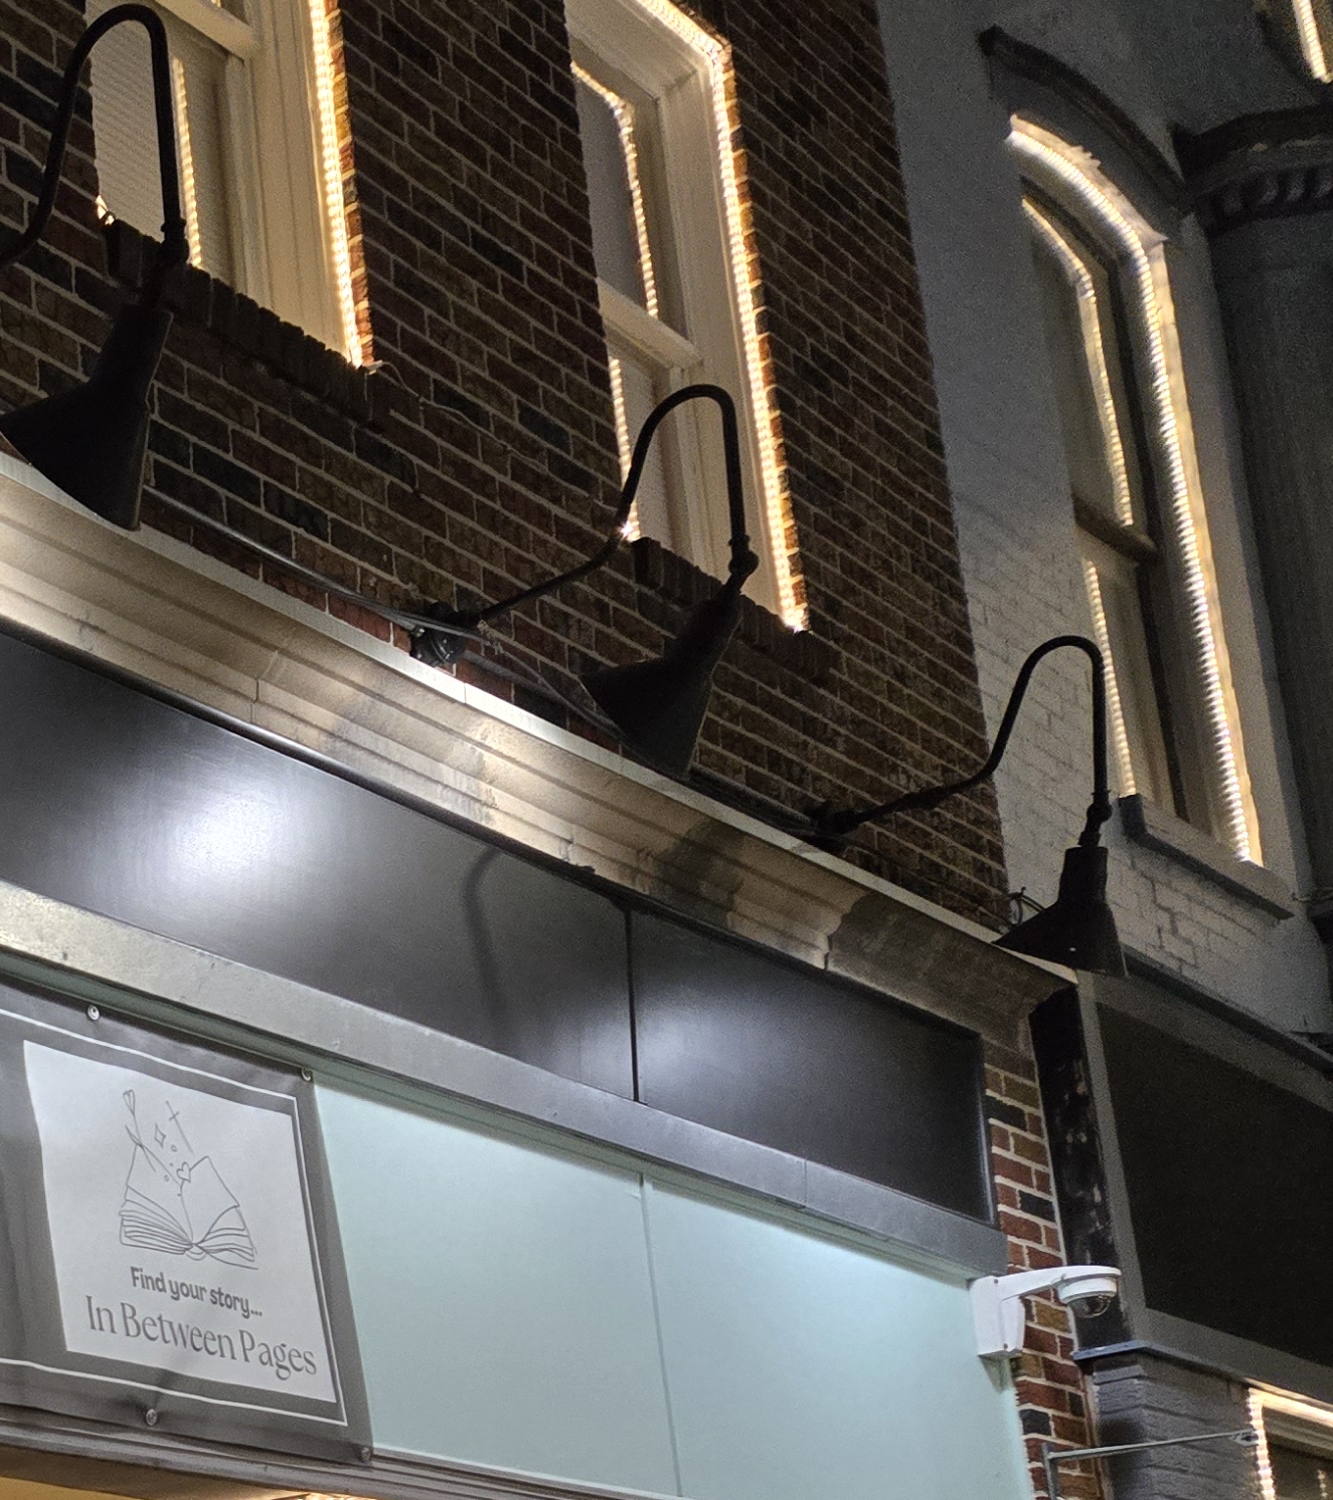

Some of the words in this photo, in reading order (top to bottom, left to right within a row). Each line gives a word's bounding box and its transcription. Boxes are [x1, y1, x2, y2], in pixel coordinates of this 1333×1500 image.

[130, 1266, 167, 1294] Find
[168, 1279, 209, 1302] your
[209, 1286, 263, 1319] story...
[85, 1295, 117, 1334] In
[119, 1301, 237, 1361] Between
[238, 1329, 318, 1381] Pages
